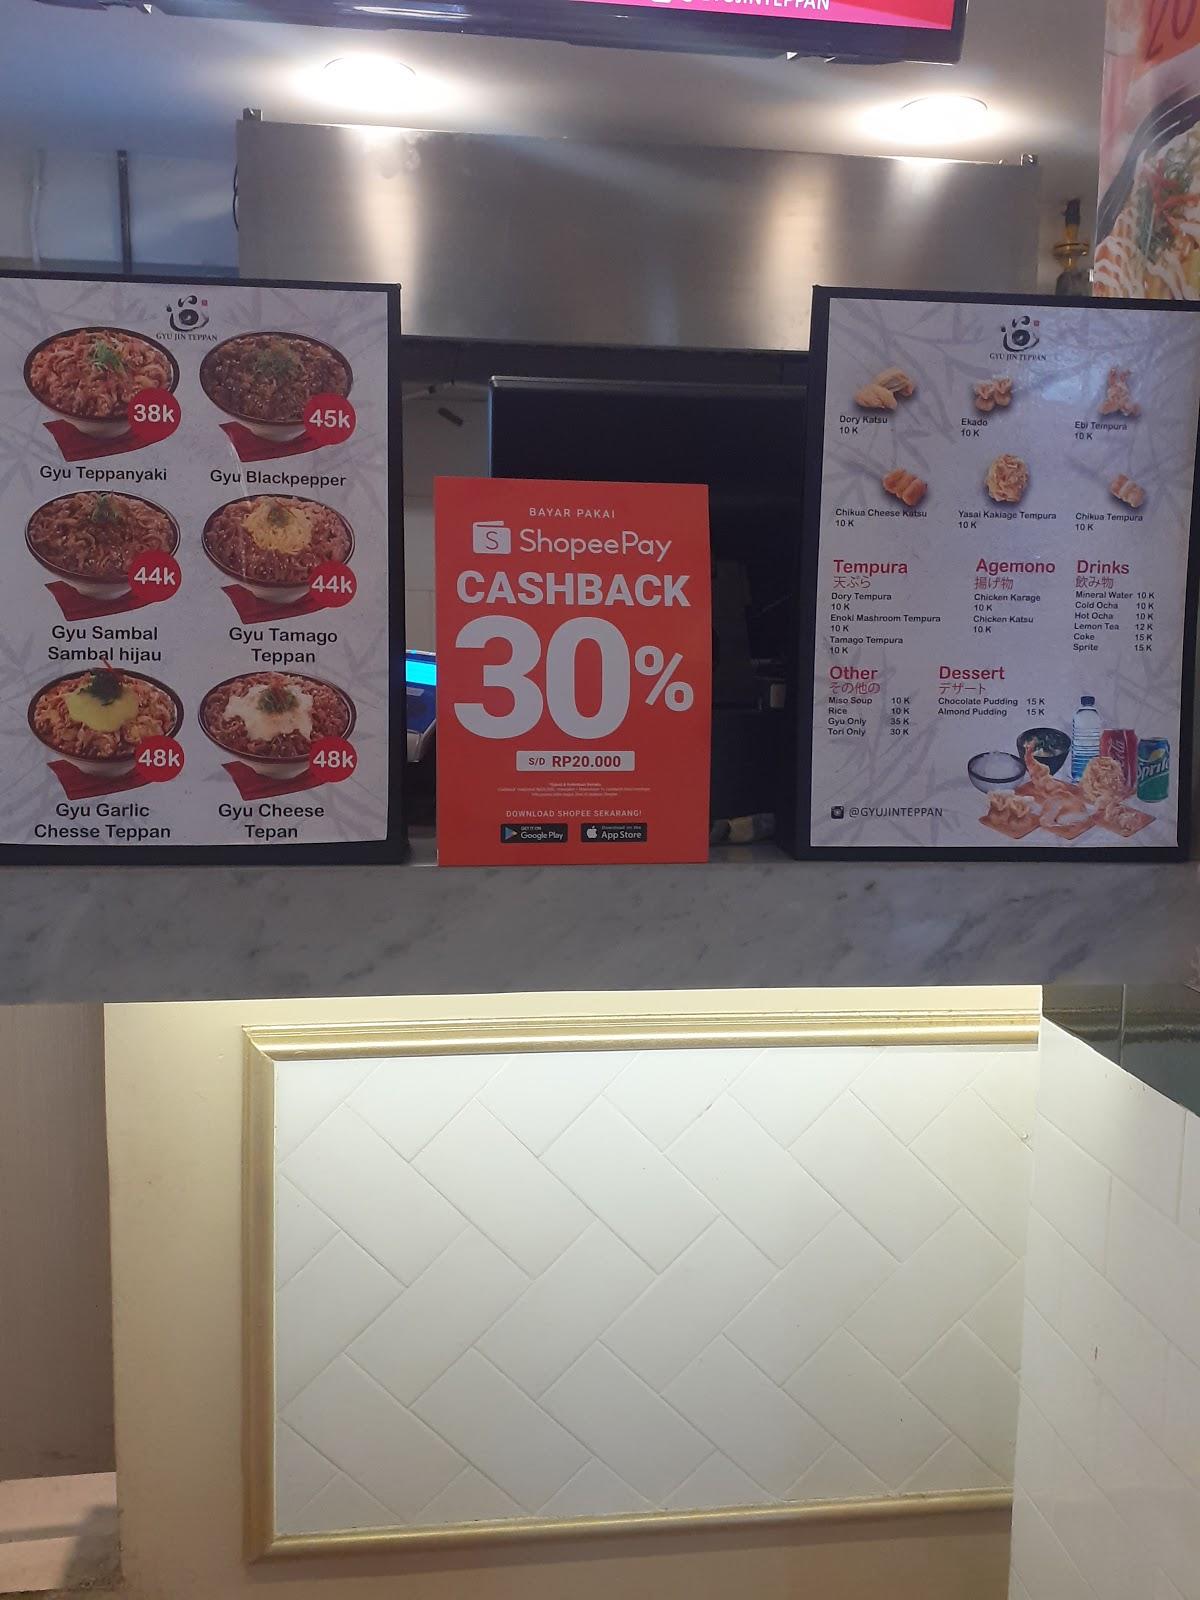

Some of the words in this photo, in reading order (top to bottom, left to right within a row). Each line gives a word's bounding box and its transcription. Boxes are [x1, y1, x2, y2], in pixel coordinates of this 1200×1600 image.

[134, 404, 175, 422] 38k
[308, 409, 350, 428] 45k
[840, 416, 860, 424] Dory
[1091, 422, 1128, 431] Tempura
[40, 465, 71, 482] Gyu
[76, 466, 167, 483] Teppanyaki
[210, 470, 241, 485] Gyu
[246, 470, 346, 488] Blackpepper
[529, 508, 570, 517] BAYAR
[576, 509, 616, 518] PAKAI
[984, 511, 1017, 520] Kakiage
[1020, 512, 1056, 520] Tempura
[1107, 513, 1143, 522] Tempura
[519, 528, 672, 562] ShopeePay
[833, 560, 908, 576] Tempura
[976, 558, 1056, 576] Agemono
[1077, 560, 1129, 574] Drinks
[134, 566, 176, 585] 44k
[311, 574, 352, 594] 44k
[456, 570, 692, 606] CASHBACK
[832, 592, 852, 601] Dory
[854, 592, 892, 601] Tempura
[1010, 594, 1040, 603] Karage
[904, 615, 941, 623] Tempura
[52, 626, 86, 642] Gyu
[92, 626, 158, 640] Sambal
[229, 627, 264, 644] Gyu
[268, 628, 338, 646] Tamago
[830, 636, 863, 645] Tamago
[866, 636, 903, 644] Tempura
[48, 646, 114, 660] Sambal
[120, 647, 162, 664] hijau
[252, 648, 315, 666] Teppan
[454, 614, 694, 740] 30%
[830, 666, 878, 679] Other
[939, 666, 1005, 680] Dessert
[829, 682, 880, 694] その他の
[939, 682, 986, 695] デザート
[850, 697, 872, 705] Soup
[983, 698, 1018, 706] Pudding
[973, 708, 1007, 717] Pudding
[828, 718, 845, 726] Gyu
[848, 718, 866, 726] Only
[847, 728, 866, 736] Only
[138, 748, 180, 767] 48k
[312, 750, 354, 768] 48k
[528, 757, 546, 766] S/D
[552, 756, 621, 768] RP20.000
[56, 803, 90, 820] Gyu
[96, 803, 150, 817] Garlic
[218, 804, 252, 820] Gyu
[258, 804, 324, 818] Cheese
[849, 808, 942, 818] @GYUJINTEPPAN
[34, 824, 100, 838] Chesse
[105, 824, 170, 841] Teppan
[244, 824, 298, 841] Tepan
[520, 832, 548, 840] Google
[549, 832, 564, 840] Play
[601, 830, 618, 840] App
[620, 830, 642, 838] Store
